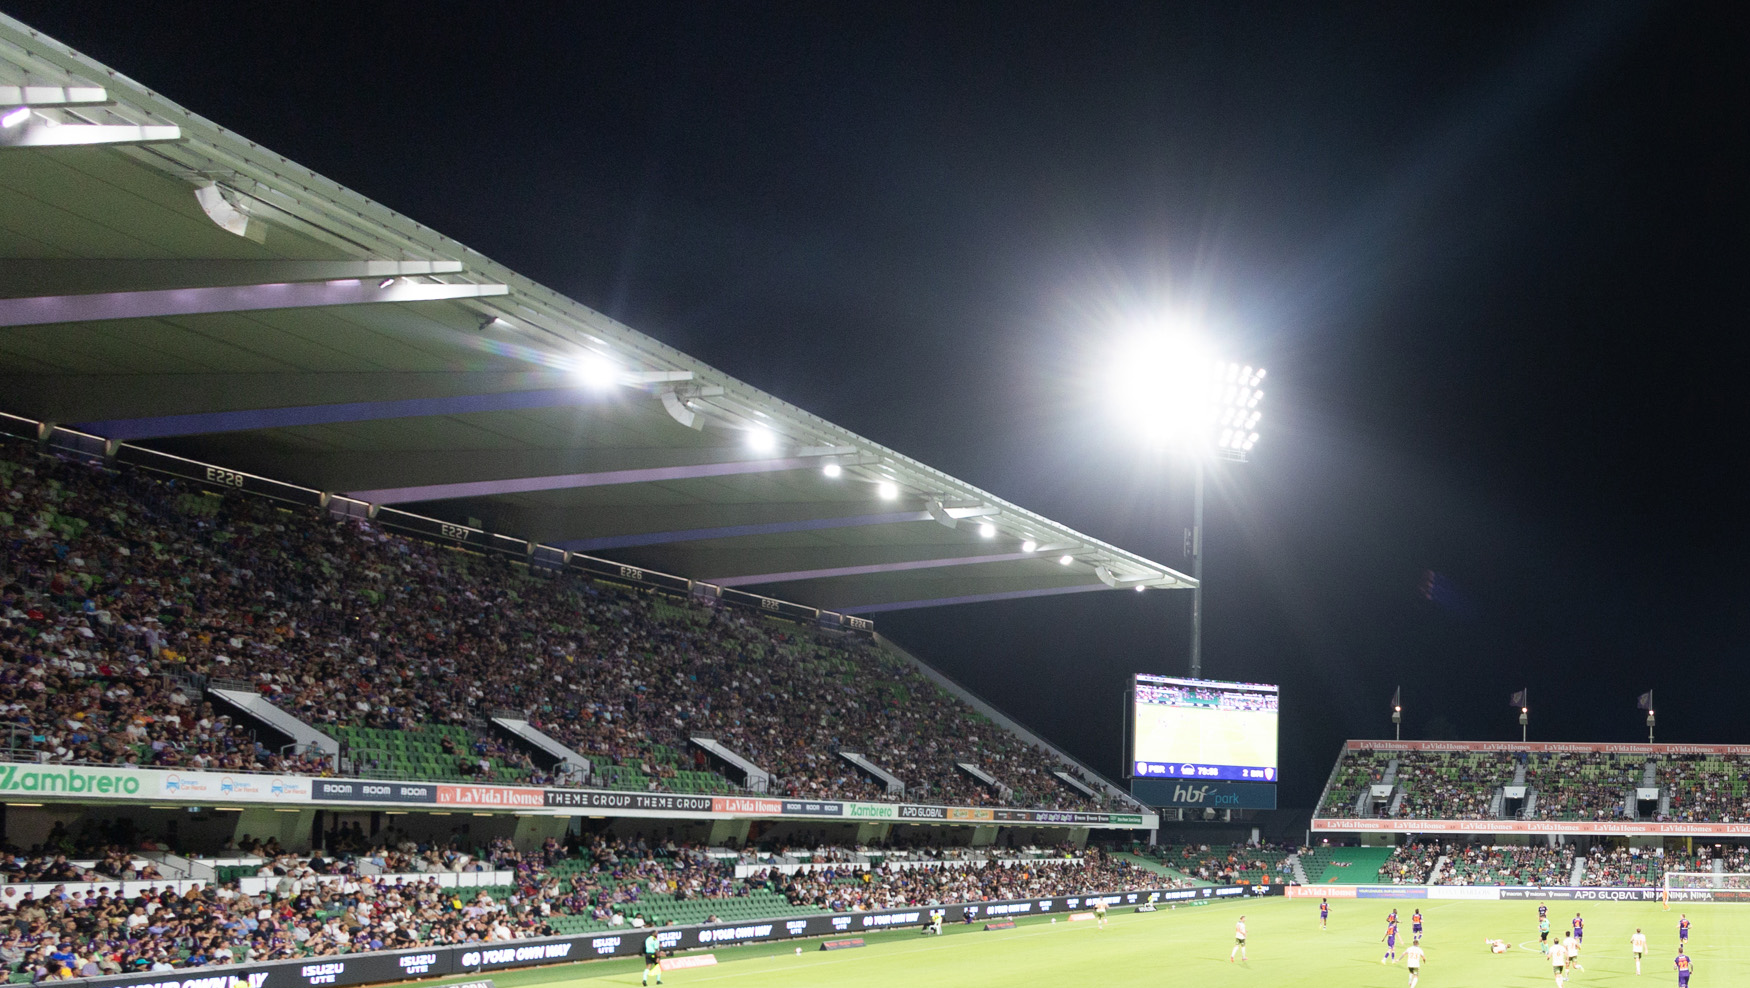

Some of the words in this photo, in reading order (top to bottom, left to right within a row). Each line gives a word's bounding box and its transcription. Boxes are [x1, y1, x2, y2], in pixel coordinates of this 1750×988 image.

[207, 468, 243, 487] E228
[442, 524, 469, 540] E227
[620, 566, 642, 580] E226
[762, 599, 779, 610] E225
[1360, 742, 1384, 750] LaVida
[0, 765, 139, 794] Zambrero
[324, 784, 352, 793] BOOM
[363, 786, 391, 794] BOOM
[401, 787, 427, 796] BOOM
[456, 788, 500, 804] LaVida
[504, 790, 544, 804] Homes
[548, 792, 588, 805] THEME
[593, 795, 630, 806] GROUP
[1173, 785, 1209, 803] hbf
[1215, 793, 1239, 806] park
[637, 796, 673, 808] THEME
[677, 798, 710, 810] GROUP
[726, 800, 754, 812] LaVida
[756, 802, 782, 812] Homes
[850, 803, 892, 818] Zambrero
[902, 808, 917, 818] APD
[918, 808, 943, 818] GLOBAL
[1327, 821, 1354, 829] LaVida
[1394, 822, 1421, 830] LaVida
[1555, 824, 1579, 832] Homes
[1660, 825, 1687, 833] LaVida
[1298, 888, 1324, 896] LaVida
[1326, 888, 1356, 896] Homes
[1574, 891, 1597, 899] APD
[1598, 891, 1638, 900] GLOBAL
[1668, 892, 1688, 900] NINJA
[1690, 892, 1712, 901] NINJA
[786, 920, 806, 930] ISUZU
[699, 930, 712, 942] GO
[713, 928, 734, 941] YOUR
[735, 927, 754, 939] OWN
[754, 925, 773, 938] WAY
[593, 937, 620, 948] ISUZU
[462, 952, 481, 966] GO
[482, 948, 515, 965] YOUR
[516, 946, 545, 962] OWN
[545, 943, 571, 960] WAY
[597, 946, 615, 954] UTE
[400, 954, 436, 966] ISUZU
[302, 963, 344, 977] ISUZU
[407, 965, 428, 974] UTE
[310, 975, 336, 984] UTE
